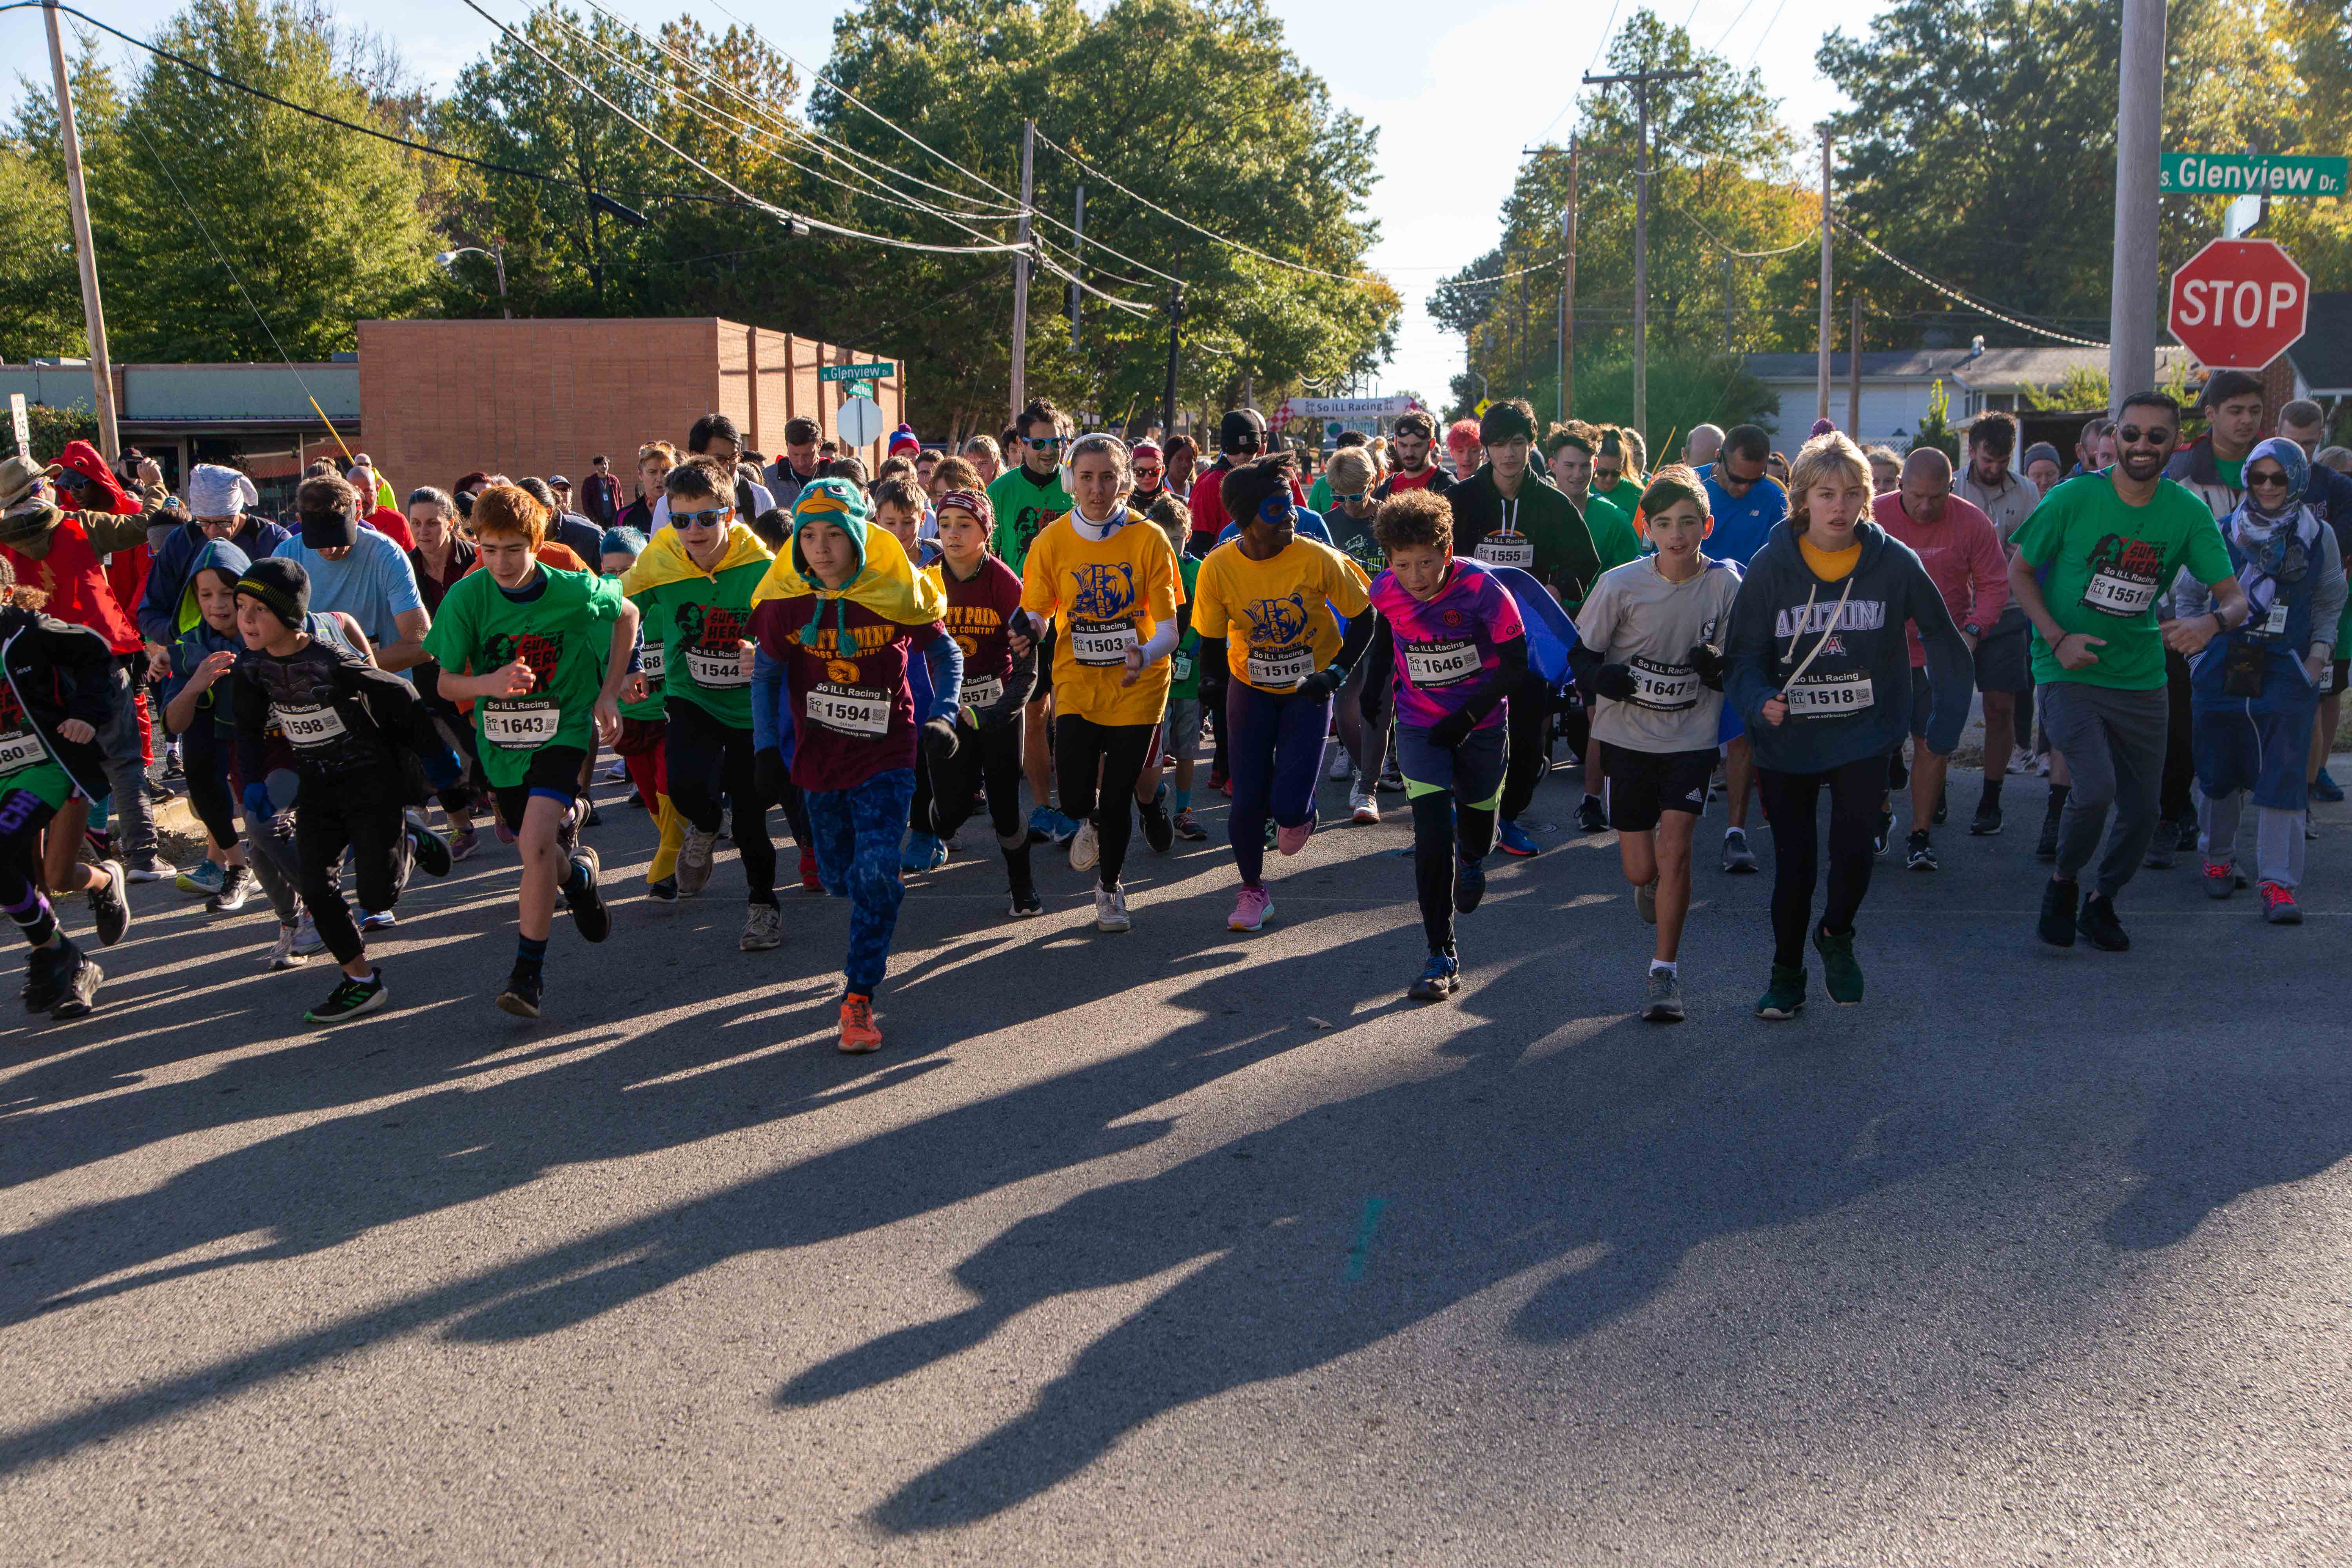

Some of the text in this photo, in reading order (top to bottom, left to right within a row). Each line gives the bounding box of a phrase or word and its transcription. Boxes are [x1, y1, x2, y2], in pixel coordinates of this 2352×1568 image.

[2179, 157, 2314, 191] Glenview
[2319, 174, 2339, 191] Dr.
[2179, 279, 2298, 328] STOP
[831, 367, 880, 379] Glenview
[1317, 403, 1329, 412] So
[1348, 402, 1383, 412] Racing
[18, 421, 26, 439] 25
[1346, 421, 1374, 430] Thank
[1490, 550, 1521, 562] 1555
[2129, 545, 2166, 559] SUPER
[2104, 567, 2115, 575] So
[2131, 574, 2156, 584] Racing
[2094, 579, 2105, 587] So
[1095, 566, 1106, 617] BEARS
[2107, 585, 2143, 604] 1551
[710, 612, 748, 624] SUPER
[965, 606, 1002, 626] POIN
[959, 626, 995, 634] COUNTRY
[1100, 622, 1127, 631] Racing
[1506, 618, 1523, 635] QN
[523, 634, 564, 653] SUPER
[785, 628, 838, 650] UTY
[1086, 638, 1123, 653] 1503
[835, 647, 882, 658] CNTRY
[1435, 641, 1465, 652] Racing
[1278, 649, 1304, 659] Racing
[643, 656, 661, 669] 68
[1423, 657, 1463, 673] 1646
[1637, 659, 1649, 668] So
[700, 663, 739, 677] 1544
[1263, 663, 1300, 677] 1516
[1630, 671, 1642, 681] So
[1825, 673, 1859, 681] Racing
[967, 674, 992, 685] Racing
[816, 683, 828, 692] So
[848, 688, 881, 699] Racing
[1644, 679, 1686, 696] 1647
[809, 698, 822, 706] So
[962, 688, 988, 703] 557
[1807, 690, 1854, 704] 1518
[291, 703, 321, 712] Racing
[517, 701, 549, 709] Racing
[825, 702, 870, 722] 1594
[286, 719, 324, 735] 1598
[501, 717, 544, 733] 1643
[0, 730, 23, 740] acing
[0, 746, 25, 765] 80
[1685, 794, 1703, 803] adidas
